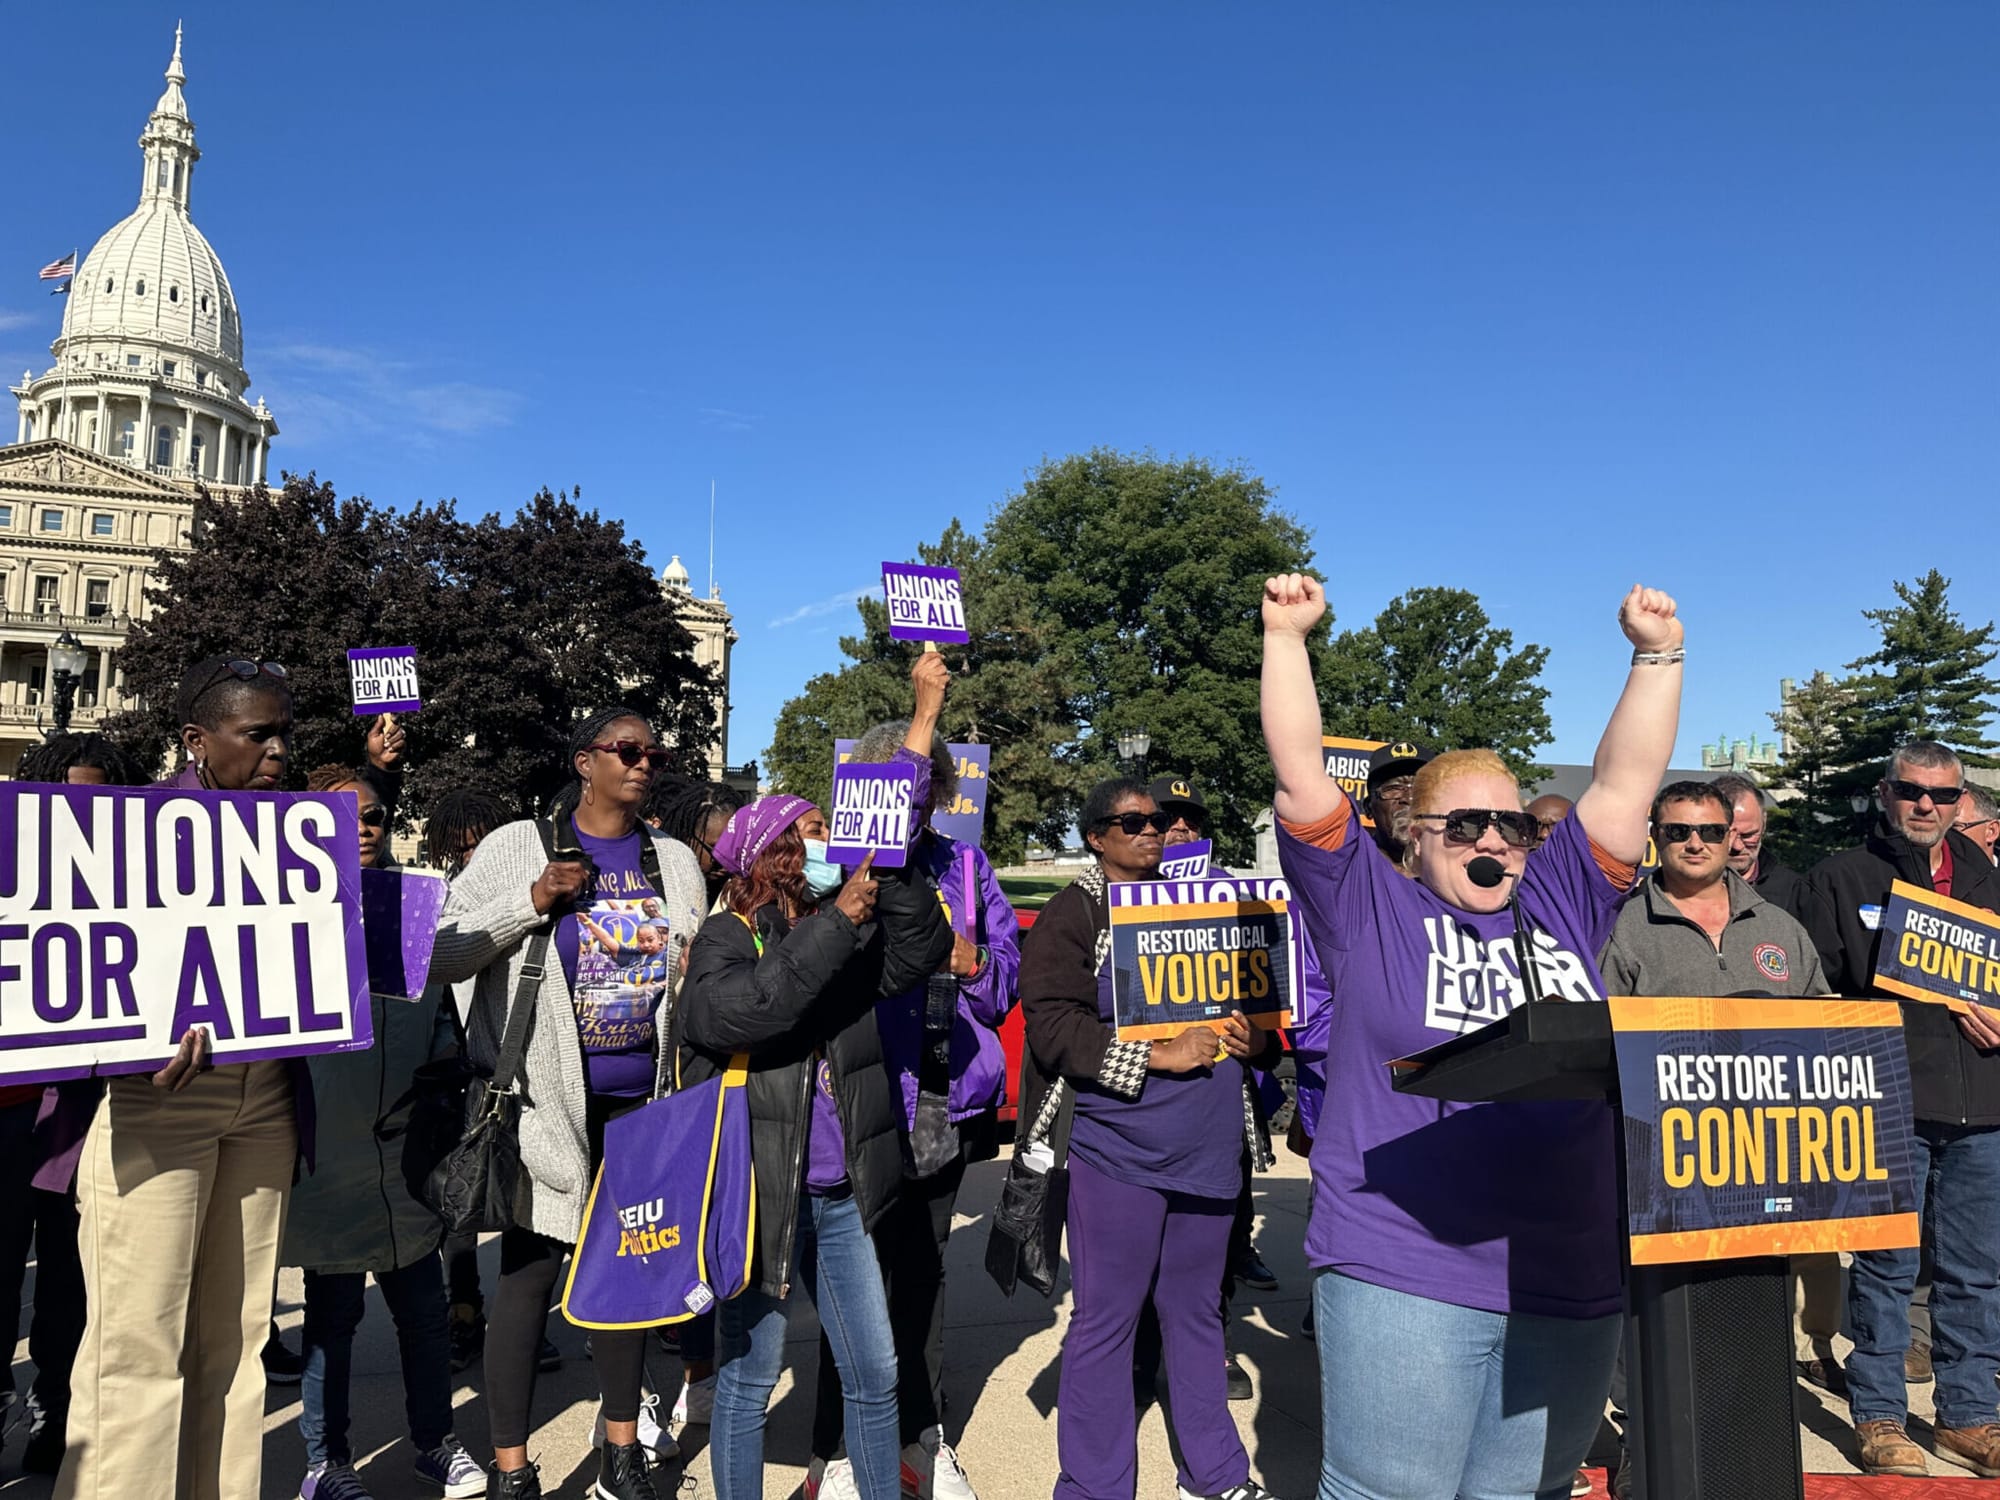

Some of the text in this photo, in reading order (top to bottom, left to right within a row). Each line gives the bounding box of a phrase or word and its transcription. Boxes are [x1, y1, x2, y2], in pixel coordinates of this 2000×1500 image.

[885, 573, 960, 601] UNIONS
[891, 598, 963, 628] FOR ALL
[351, 656, 416, 678] UNIONS
[355, 679, 417, 700] FOR ALL
[836, 778, 912, 809] UNIONS
[834, 812, 904, 845] FOR ALL
[1162, 857, 1206, 878] SEIU
[1137, 925, 1269, 954] RESTORE LOCAL
[1905, 909, 1986, 955] RESTORE
[169, 922, 344, 1044] ALL
[1138, 949, 1269, 1005] VOICES
[1436, 959, 1514, 1016] FOR
[1656, 1054, 1883, 1101] RESTORE LOCAL
[1661, 1105, 1888, 1188] CONTROL
